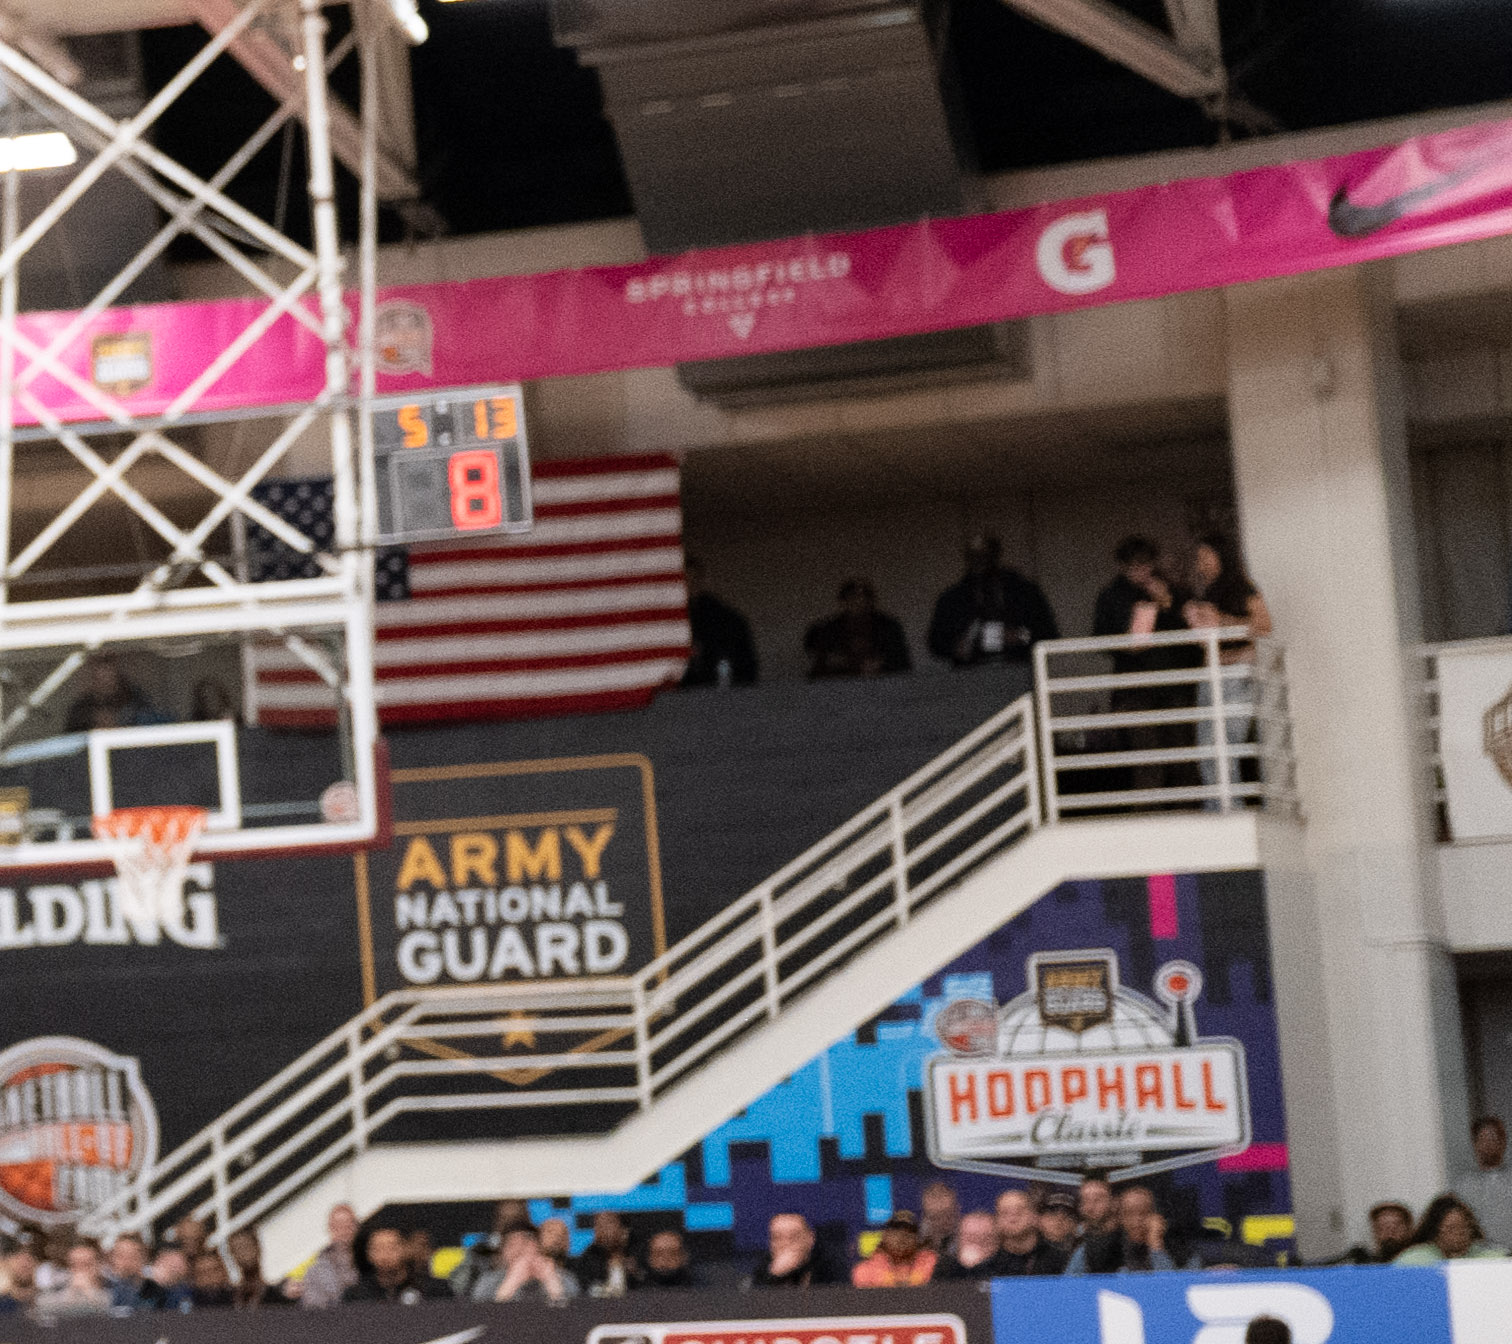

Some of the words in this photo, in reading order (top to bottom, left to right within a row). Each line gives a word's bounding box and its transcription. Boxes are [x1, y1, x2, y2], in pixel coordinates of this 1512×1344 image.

[625, 252, 851, 303] SPRINGFIELD
[447, 450, 502, 531] 8
[396, 825, 615, 890] ARMY
[395, 881, 624, 931] NATIONAL
[397, 919, 630, 985] GUARD
[948, 1060, 1227, 1124] HOOPHALL
